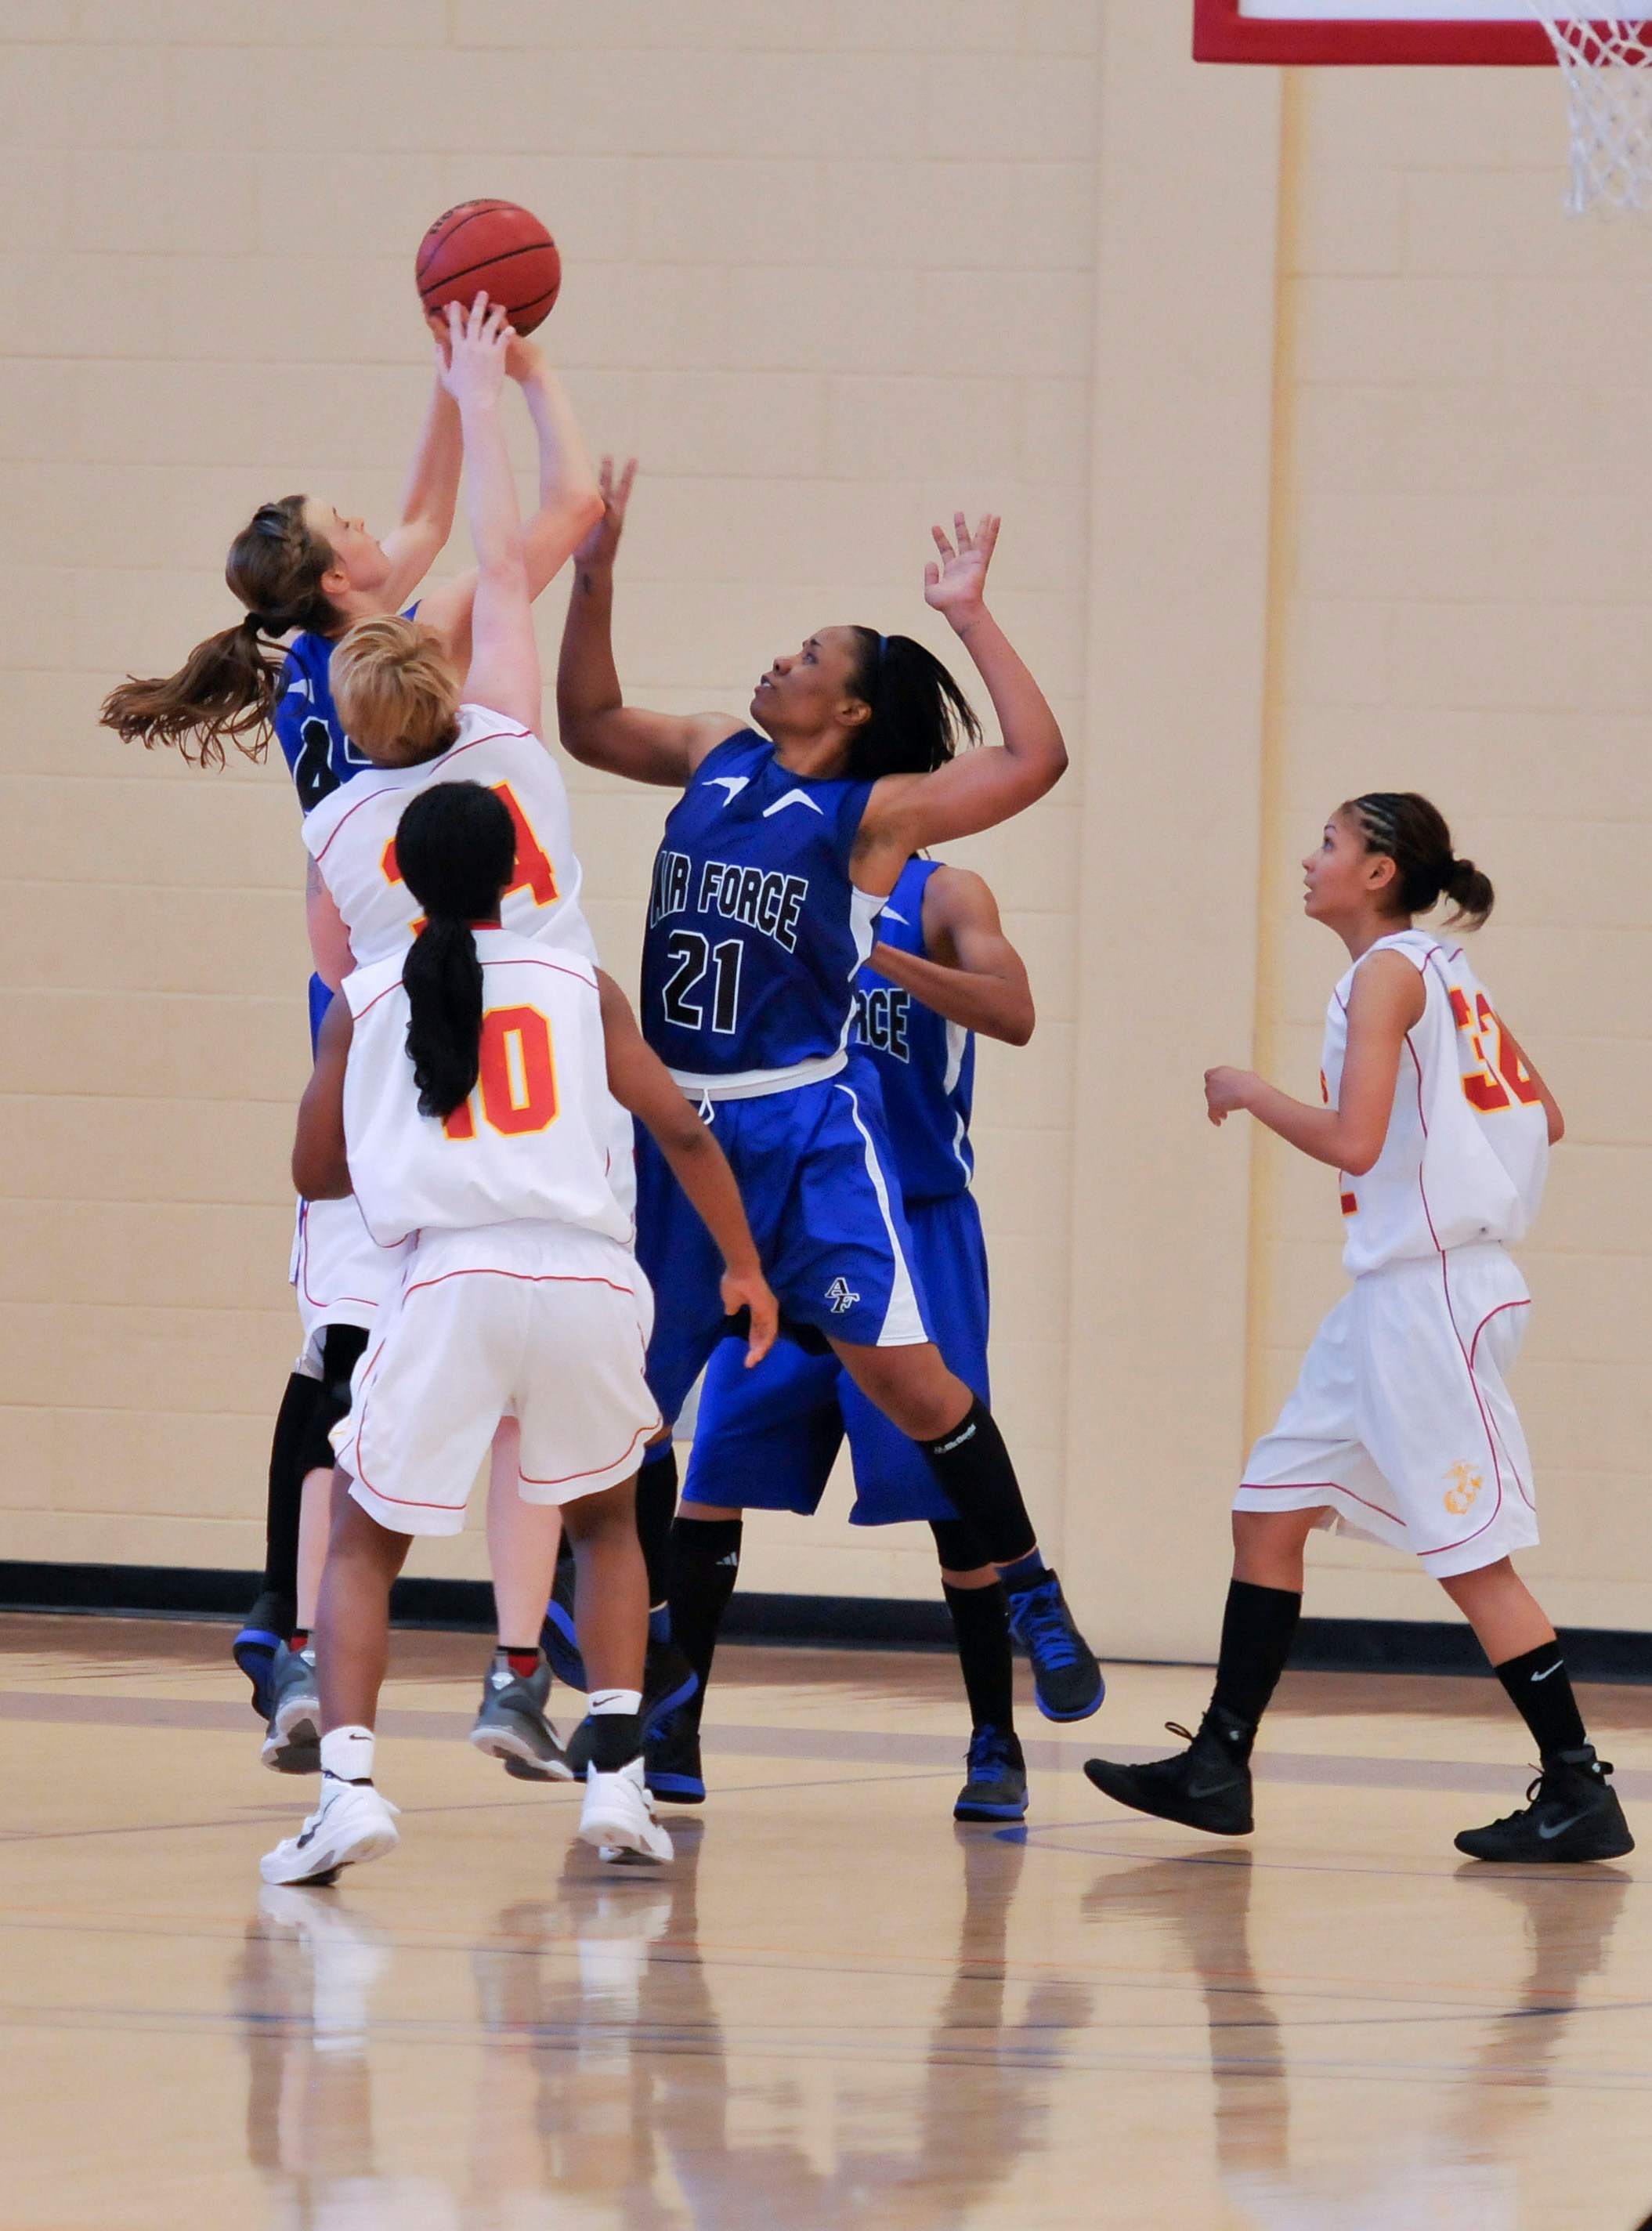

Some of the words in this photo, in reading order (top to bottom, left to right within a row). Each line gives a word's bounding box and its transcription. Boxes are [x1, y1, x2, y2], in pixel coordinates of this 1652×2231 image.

[650, 850, 692, 929] AIR
[697, 860, 809, 953] FORCE
[662, 930, 743, 1034] 21
[441, 1003, 560, 1141] 0
[1448, 985, 1541, 1115] 32
